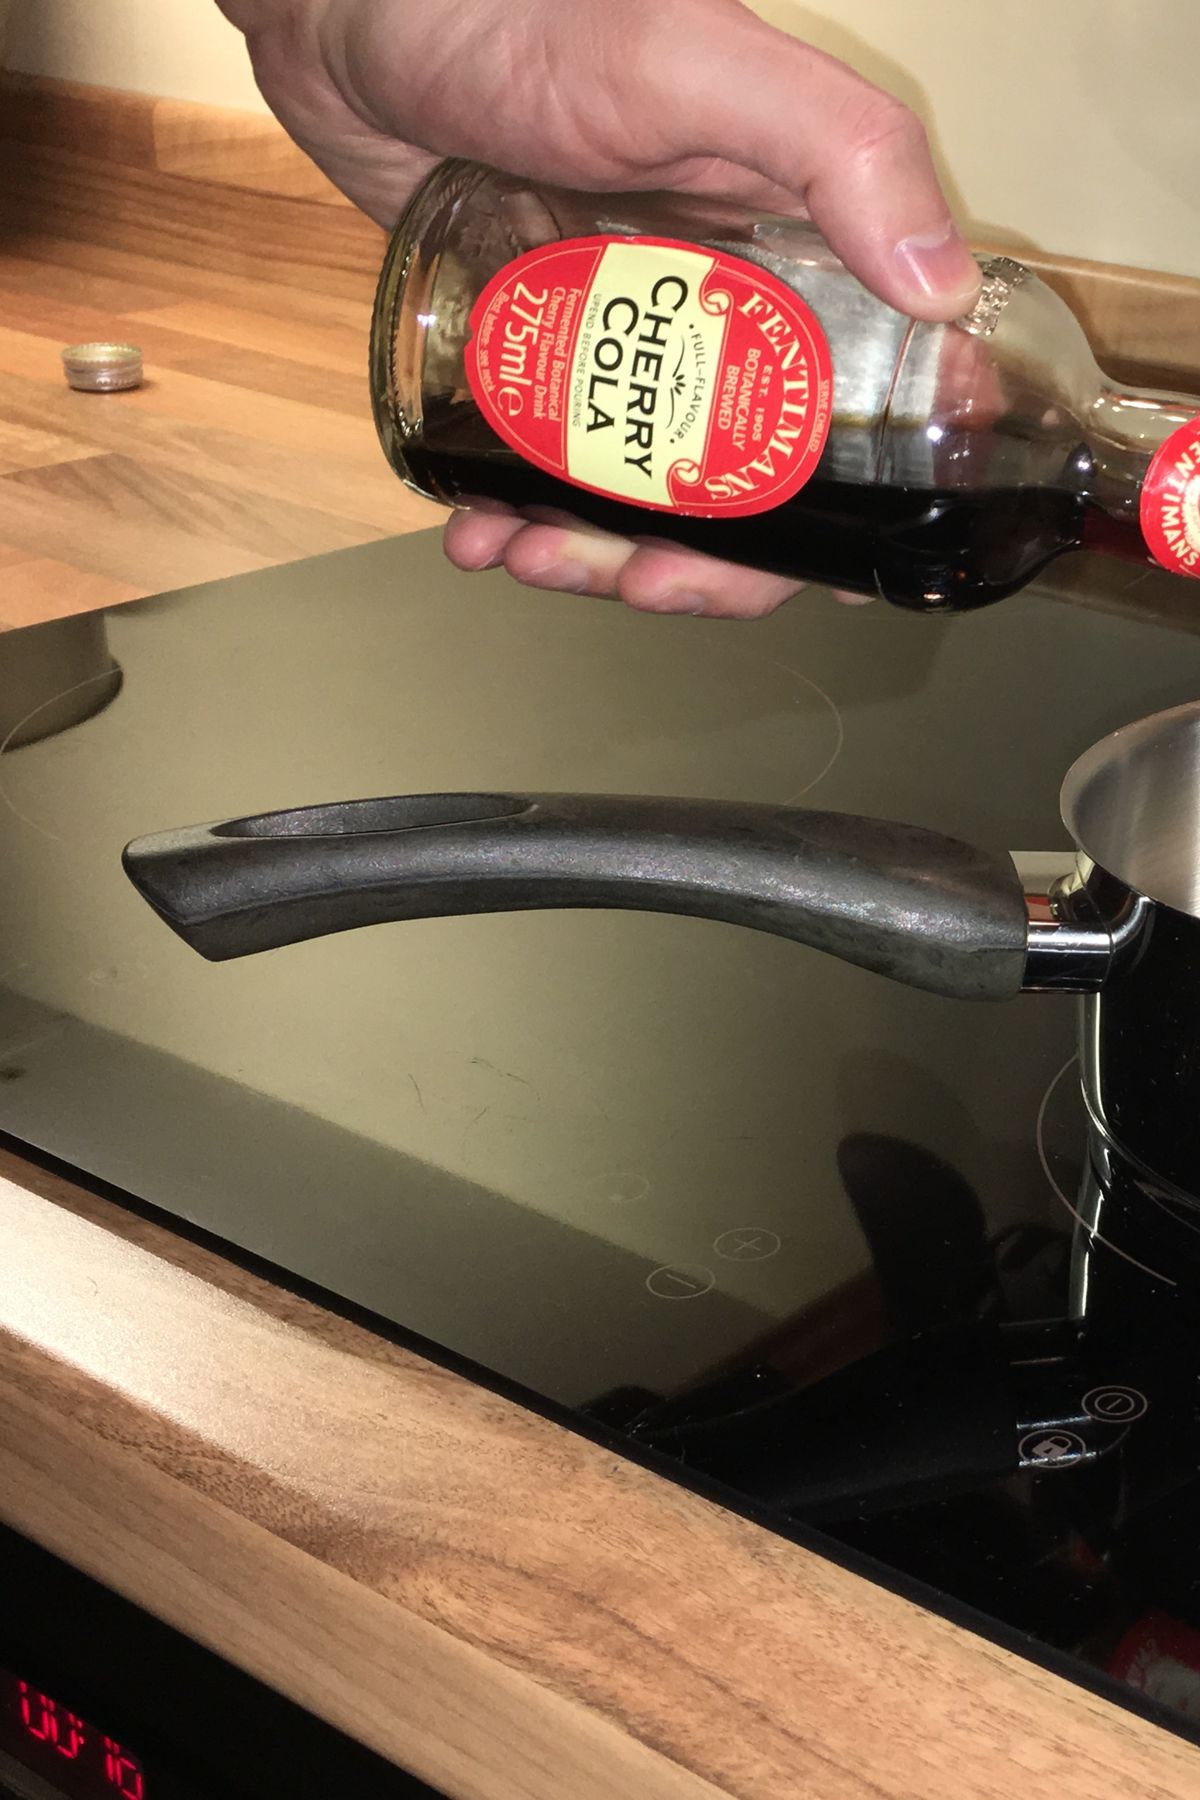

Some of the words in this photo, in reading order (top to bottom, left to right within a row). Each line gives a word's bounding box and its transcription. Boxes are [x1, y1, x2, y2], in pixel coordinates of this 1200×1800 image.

[491, 291, 510, 314] Best
[541, 286, 566, 329] Cherry
[554, 287, 582, 357] Fermented
[585, 293, 602, 329] UPEND
[479, 349, 489, 367] see
[535, 332, 554, 382] Flavour
[576, 332, 591, 375] BEFORE
[586, 296, 639, 433] COLA
[482, 368, 496, 392] neck
[548, 360, 566, 422] Botanical
[624, 275, 689, 479] CHERRY
[704, 293, 809, 500] FENTIMANS
[718, 364, 740, 430] BREWED
[758, 364, 773, 398] EST.
[819, 379, 830, 411] SERVE
[533, 384, 548, 419] Drink
[572, 379, 584, 427] POURING
[732, 347, 761, 451] BOTANICALLY
[751, 407, 765, 441] 1905
[808, 413, 827, 452] CHILLED
